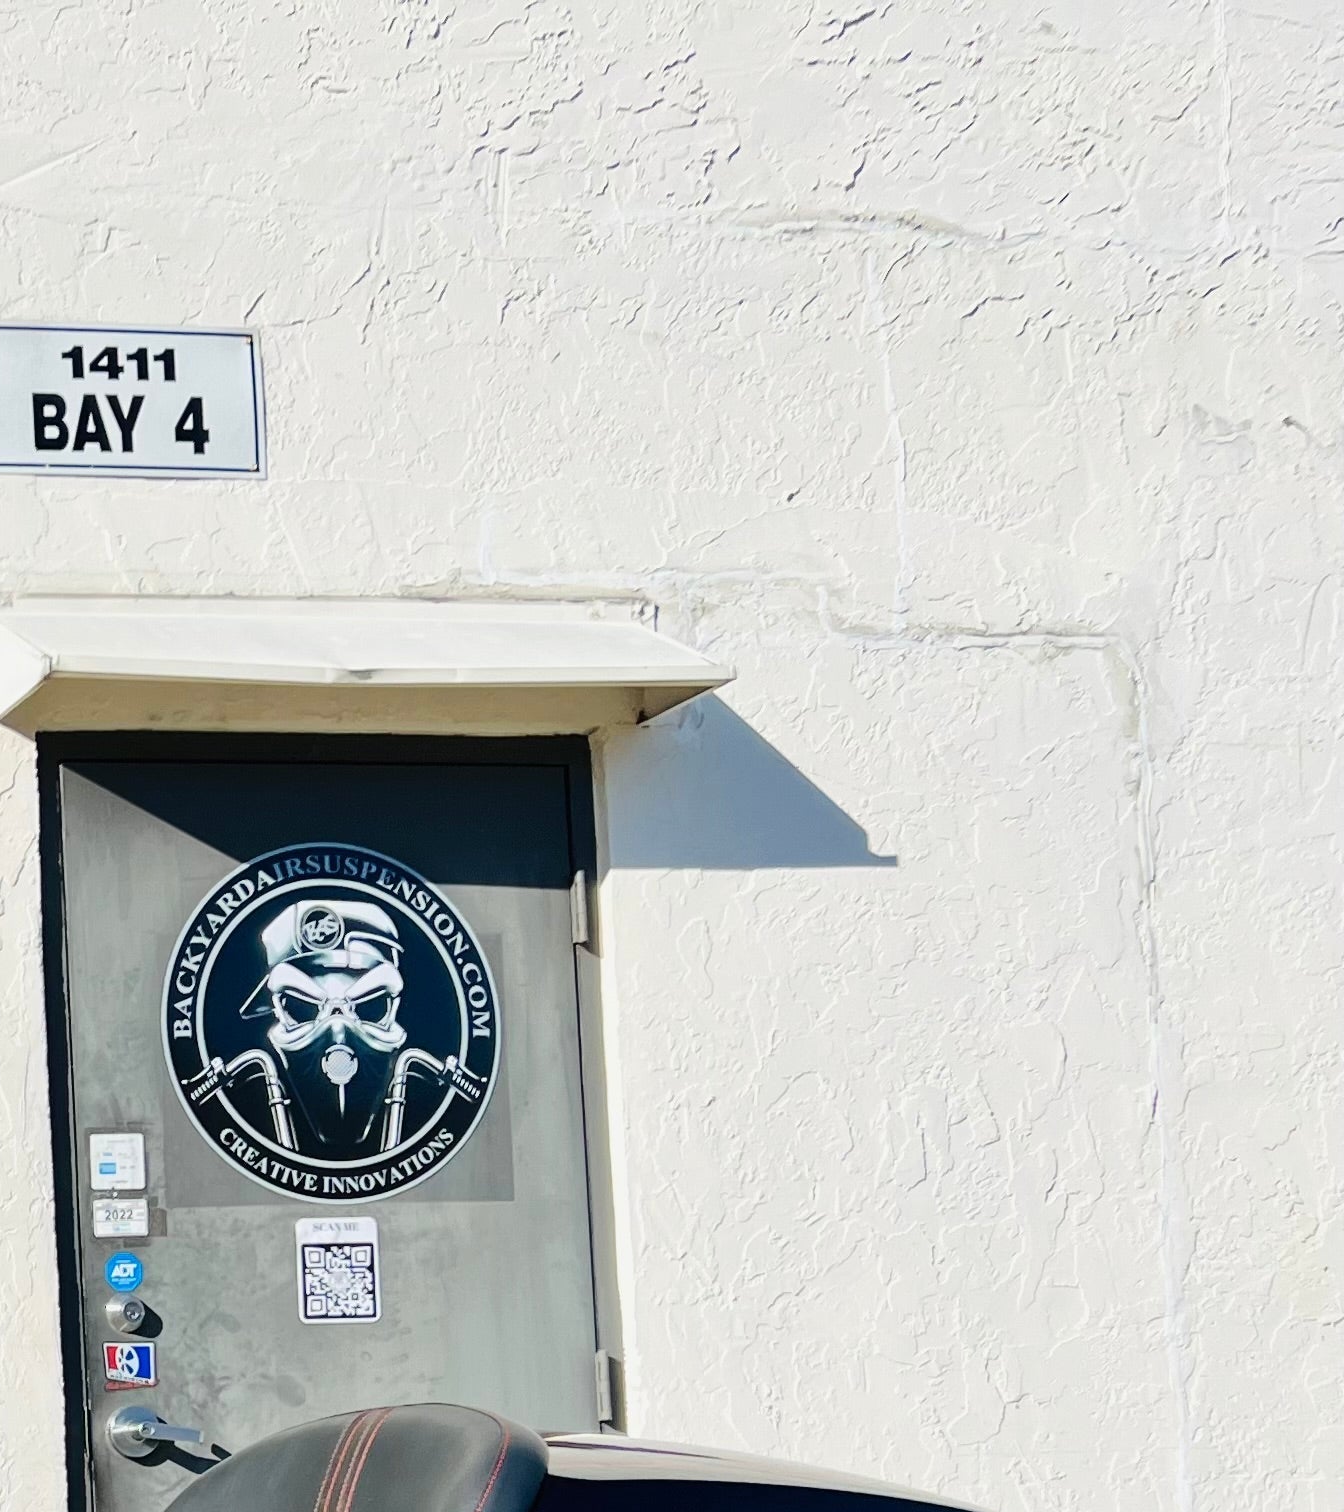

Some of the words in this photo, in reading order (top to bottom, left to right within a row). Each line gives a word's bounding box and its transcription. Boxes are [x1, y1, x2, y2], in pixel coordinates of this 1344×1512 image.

[61, 346, 177, 381] 1411
[32, 393, 145, 453] BAY
[175, 397, 210, 455] 4
[172, 853, 492, 1041] BACKYARDAIRSUSPENSION.COM
[218, 1126, 319, 1194] CREATIVE
[322, 1127, 456, 1195] INNOVATIONS
[104, 1209, 134, 1221] 2022
[111, 1263, 137, 1278] ADT
